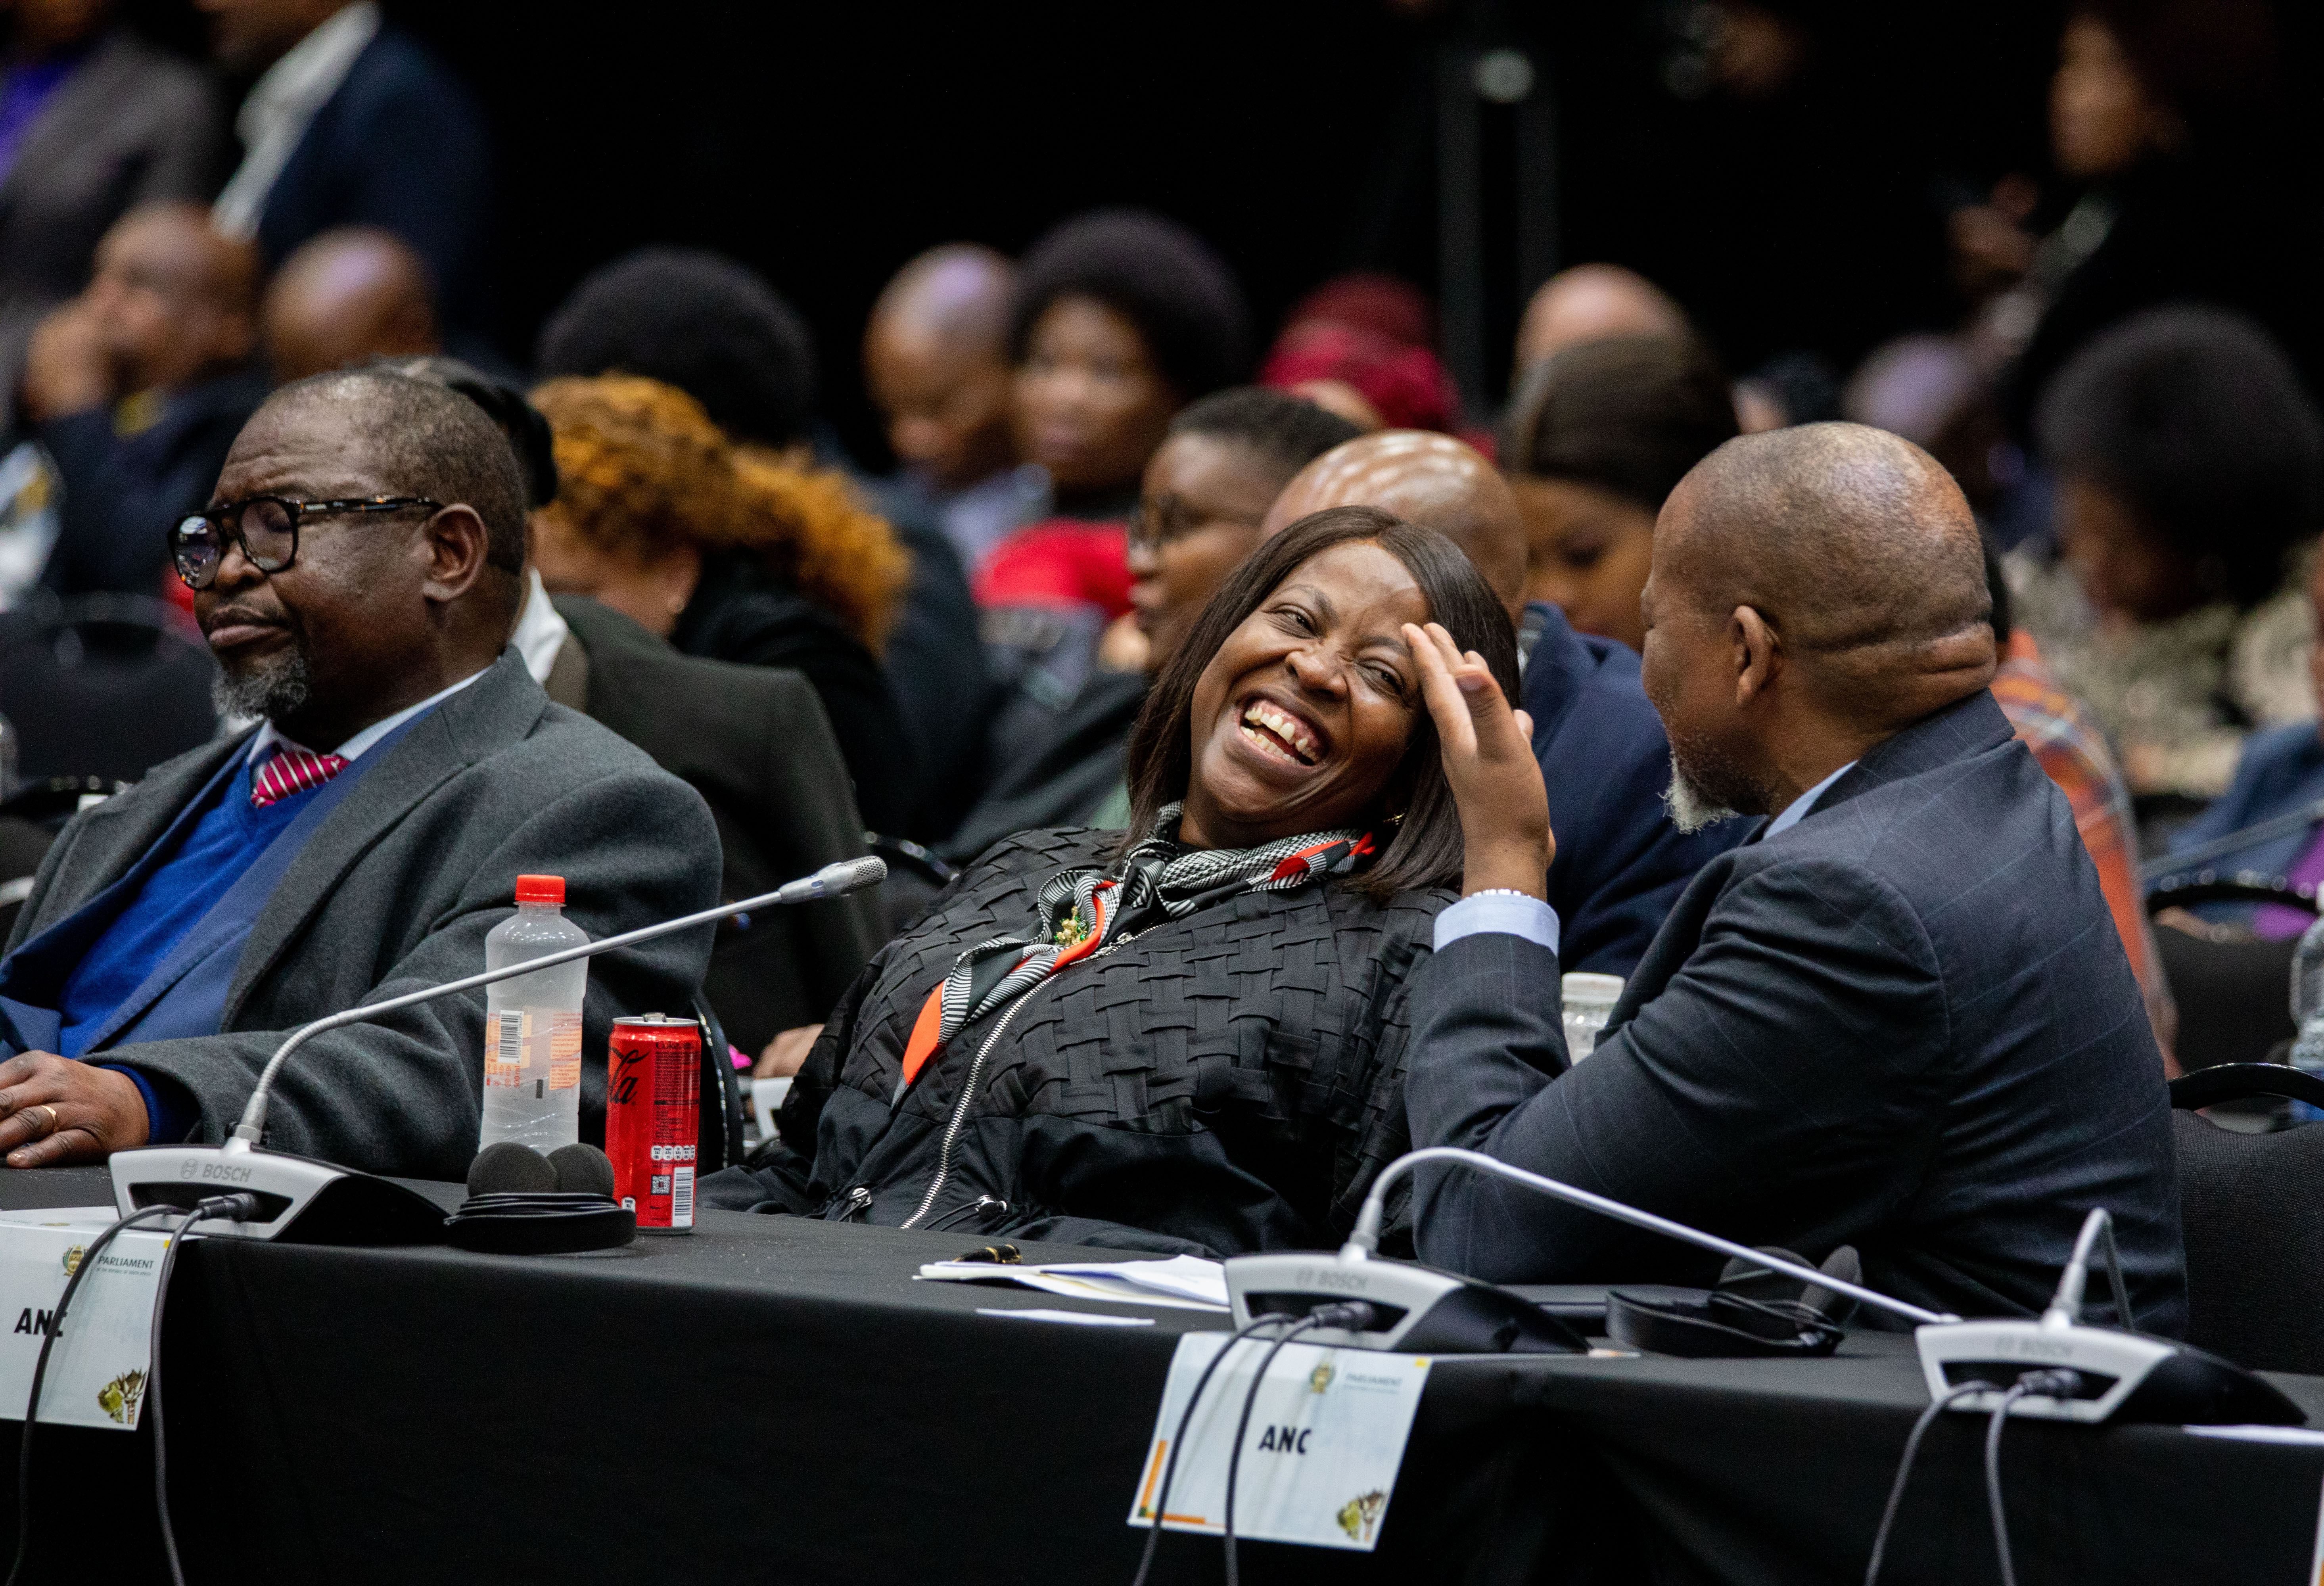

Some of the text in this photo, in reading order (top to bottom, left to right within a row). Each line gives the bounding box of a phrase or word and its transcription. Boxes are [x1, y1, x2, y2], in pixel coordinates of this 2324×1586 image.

[514, 1066, 521, 1074] ml
[203, 1164, 252, 1182] BOSCH
[98, 1255, 155, 1269] PARLIAMENT
[1319, 1270, 1368, 1290] BOSCH
[1258, 1425, 1312, 1454] ANC
